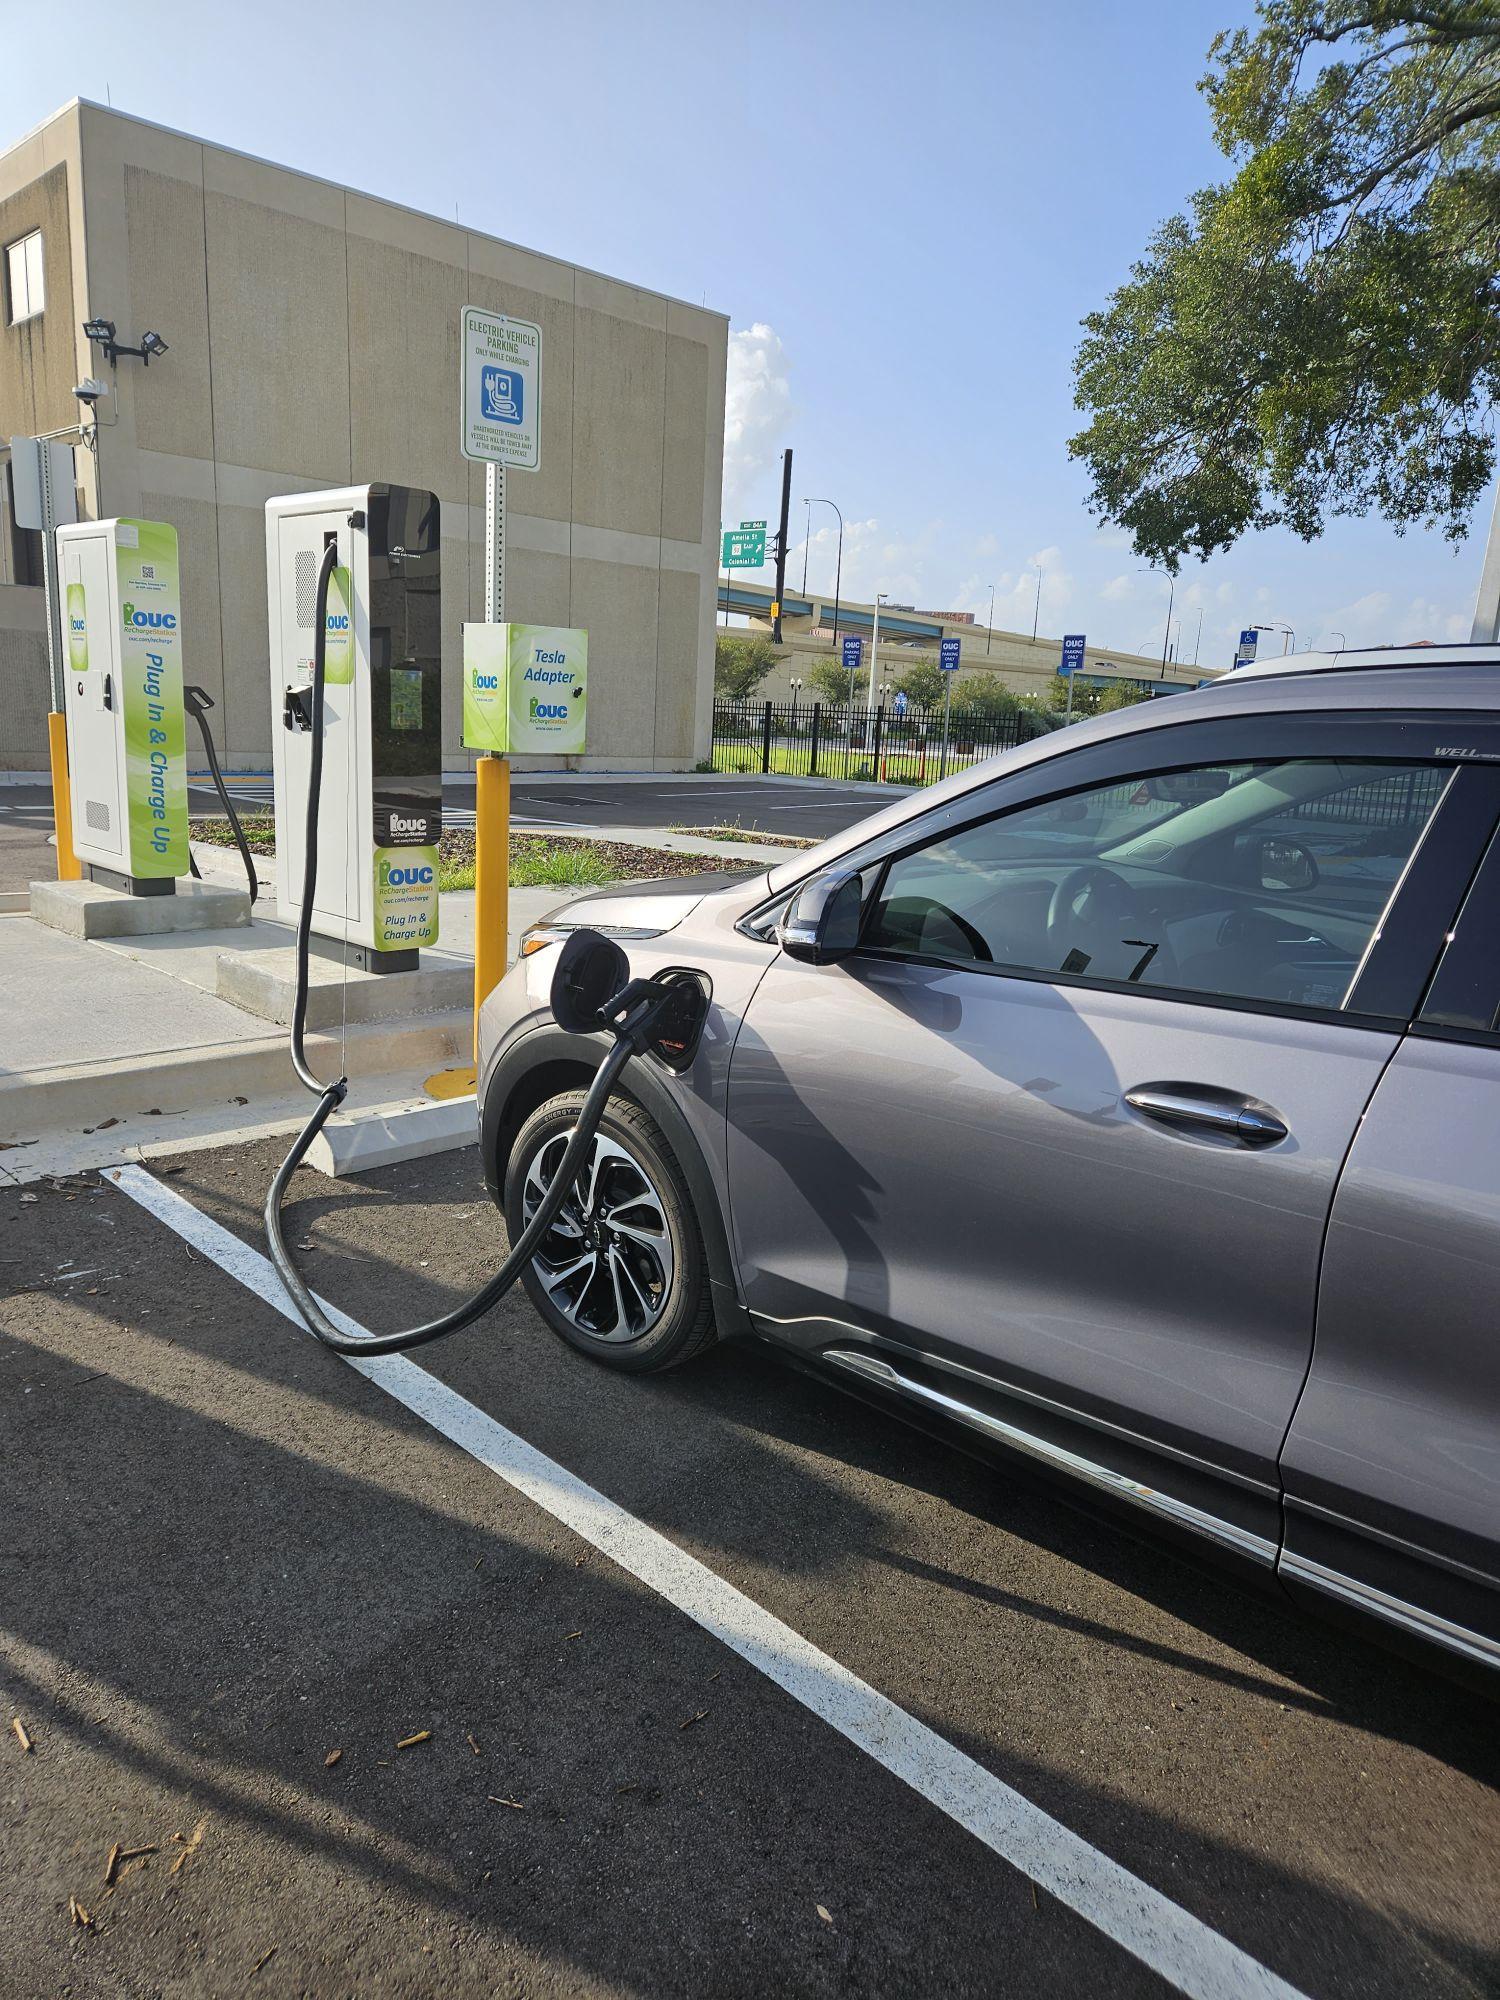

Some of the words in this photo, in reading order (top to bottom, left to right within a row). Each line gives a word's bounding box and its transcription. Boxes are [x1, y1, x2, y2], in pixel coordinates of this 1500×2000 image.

[469, 319, 504, 339] ELECTRIC
[507, 329, 536, 347] VEHICLE
[487, 336, 519, 354] PARKING
[475, 346, 488, 357] ONLY
[488, 350, 504, 361] WHILE
[505, 354, 530, 367] CHARGING
[534, 649, 566, 664] Tesla
[143, 652, 165, 698] Plug
[523, 667, 576, 686] Adapter
[148, 703, 165, 722] In
[149, 728, 167, 744] &
[148, 751, 168, 821] Charge
[150, 827, 170, 854] Up
[379, 885, 433, 895] ReChargeStation
[383, 896, 429, 904] ouc.com/recharge
[385, 915, 406, 928] Plug
[408, 914, 417, 923] In
[418, 913, 427, 923] &
[383, 929, 416, 941] Charge
[418, 927, 431, 939] Up
